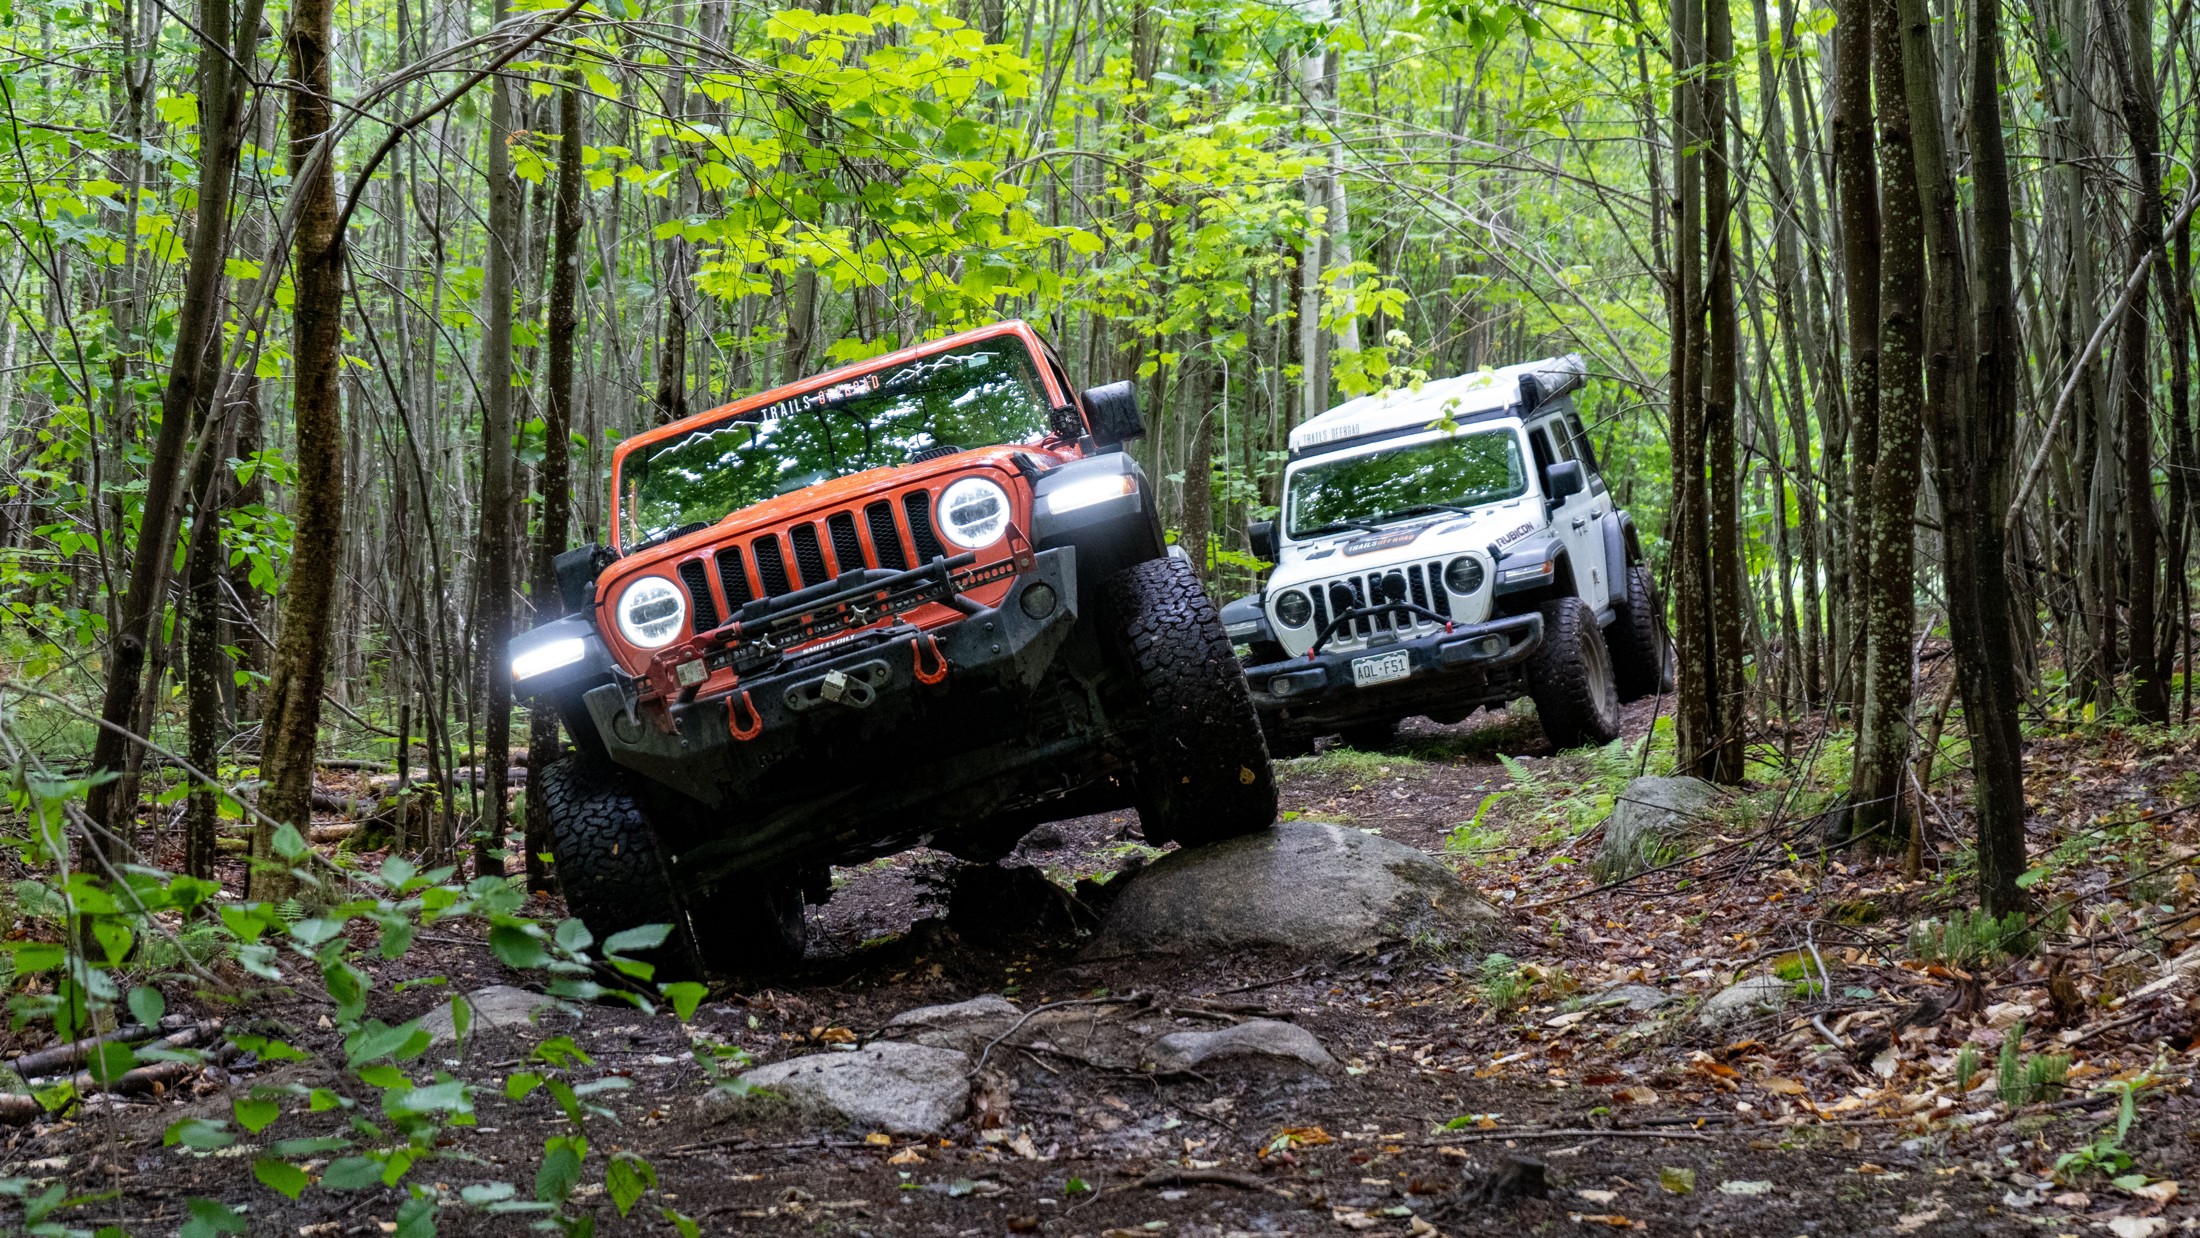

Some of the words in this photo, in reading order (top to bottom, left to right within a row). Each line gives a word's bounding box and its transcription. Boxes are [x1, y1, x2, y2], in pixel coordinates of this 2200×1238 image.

[761, 395, 811, 421] TRAILS
[1303, 430, 1327, 445] TRAILS
[1332, 424, 1360, 439] OFFROAD
[1495, 521, 1534, 547] RUBICON
